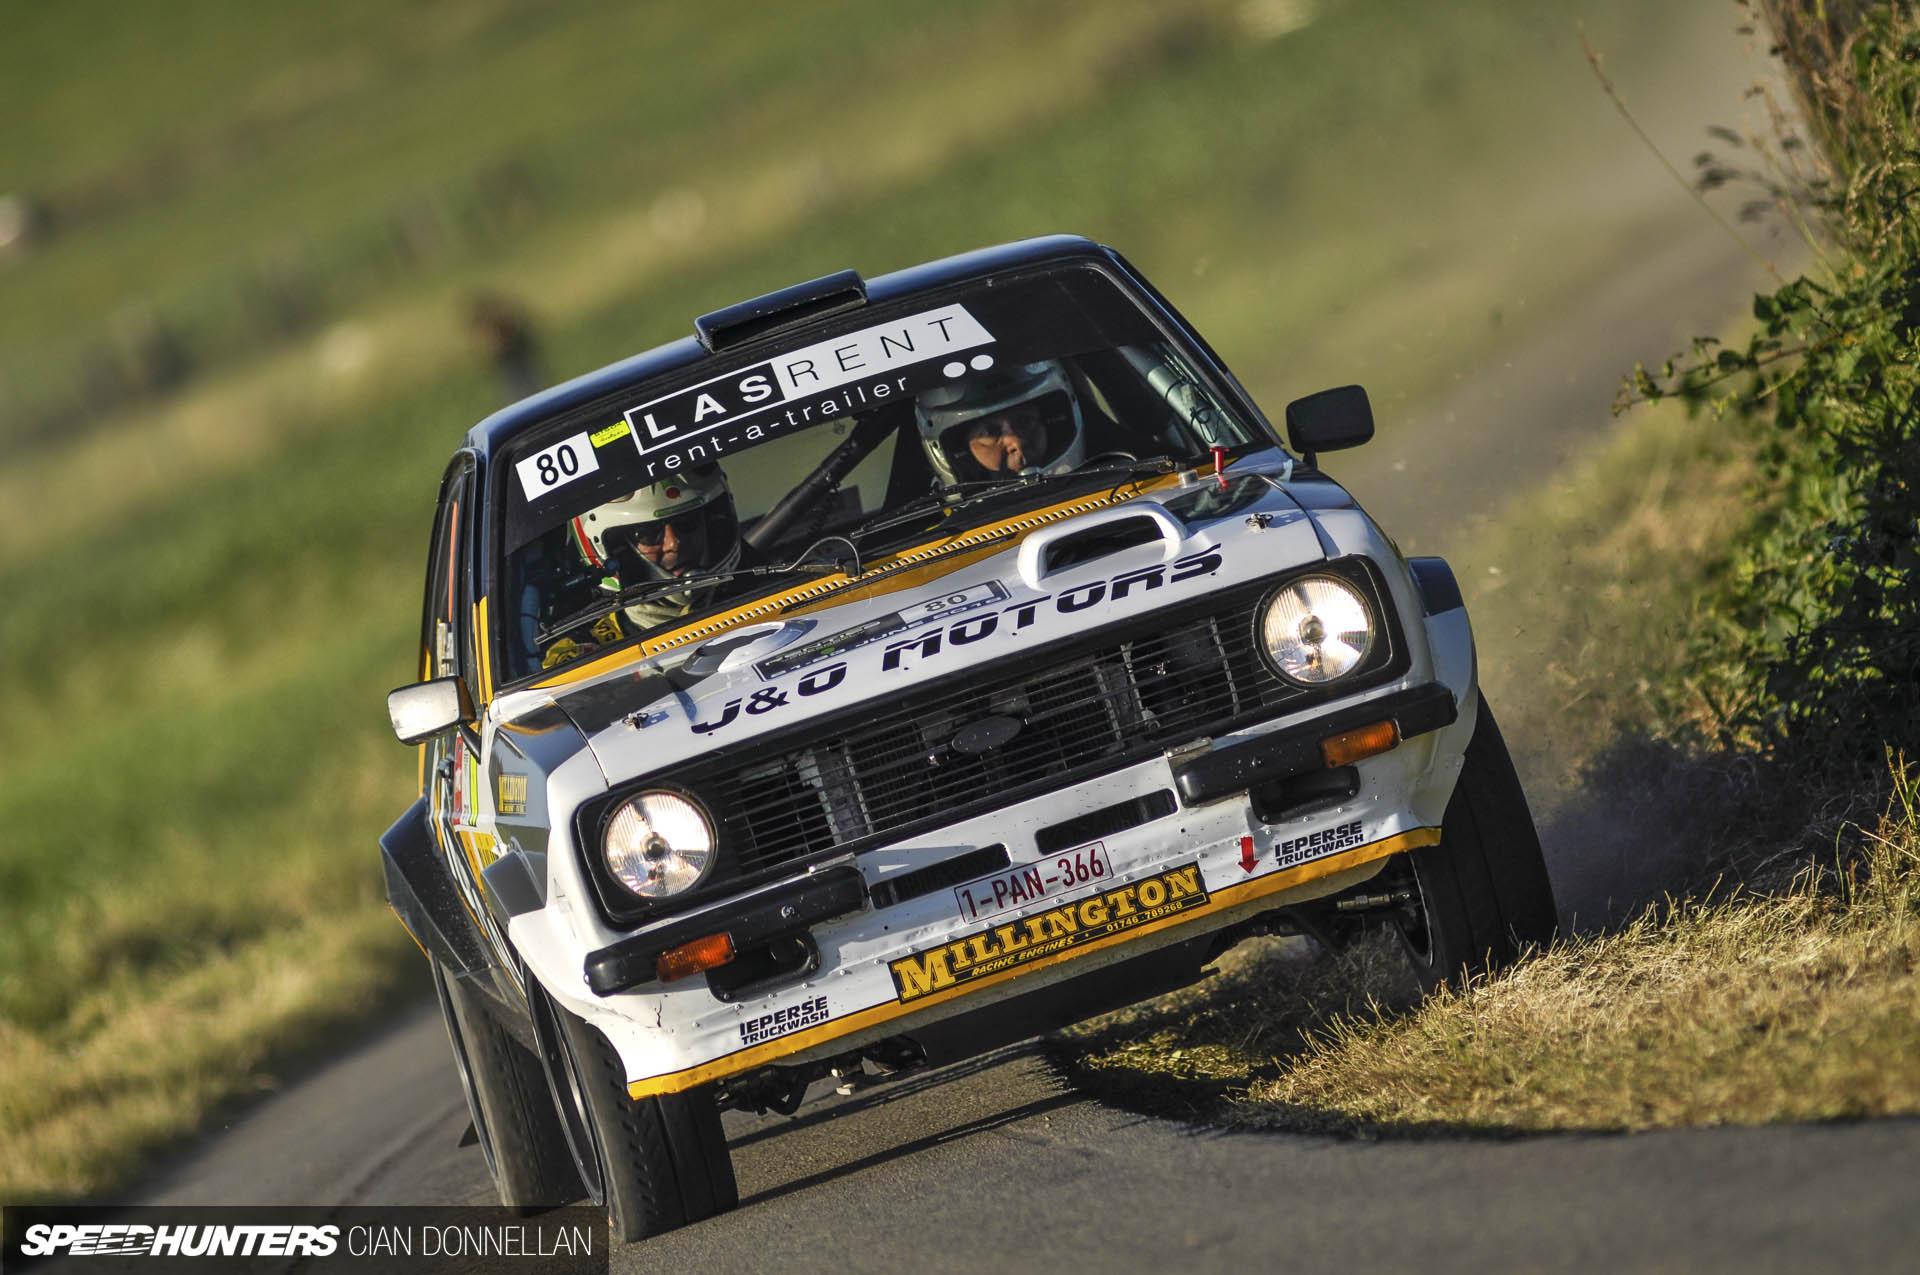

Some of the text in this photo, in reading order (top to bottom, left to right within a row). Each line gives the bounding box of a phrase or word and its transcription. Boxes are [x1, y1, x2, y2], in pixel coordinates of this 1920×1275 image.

[646, 376, 909, 477] rent-a-trailer
[535, 443, 580, 487] 80
[925, 594, 968, 612] 80
[690, 661, 848, 736] J&O
[882, 543, 1223, 672] MOTORS
[1274, 820, 1363, 858] IEPERSE
[1275, 833, 1364, 867] TRUCKWASH
[961, 848, 1105, 919] 1-PAN-366
[892, 867, 1202, 1000] MILLINGTON
[970, 955, 1015, 978] RACING
[1018, 936, 1075, 961] ENGINES
[1106, 916, 1139, 933] 01746
[739, 995, 828, 1036] IEPERSE
[741, 1009, 830, 1046] TRUCKWASH
